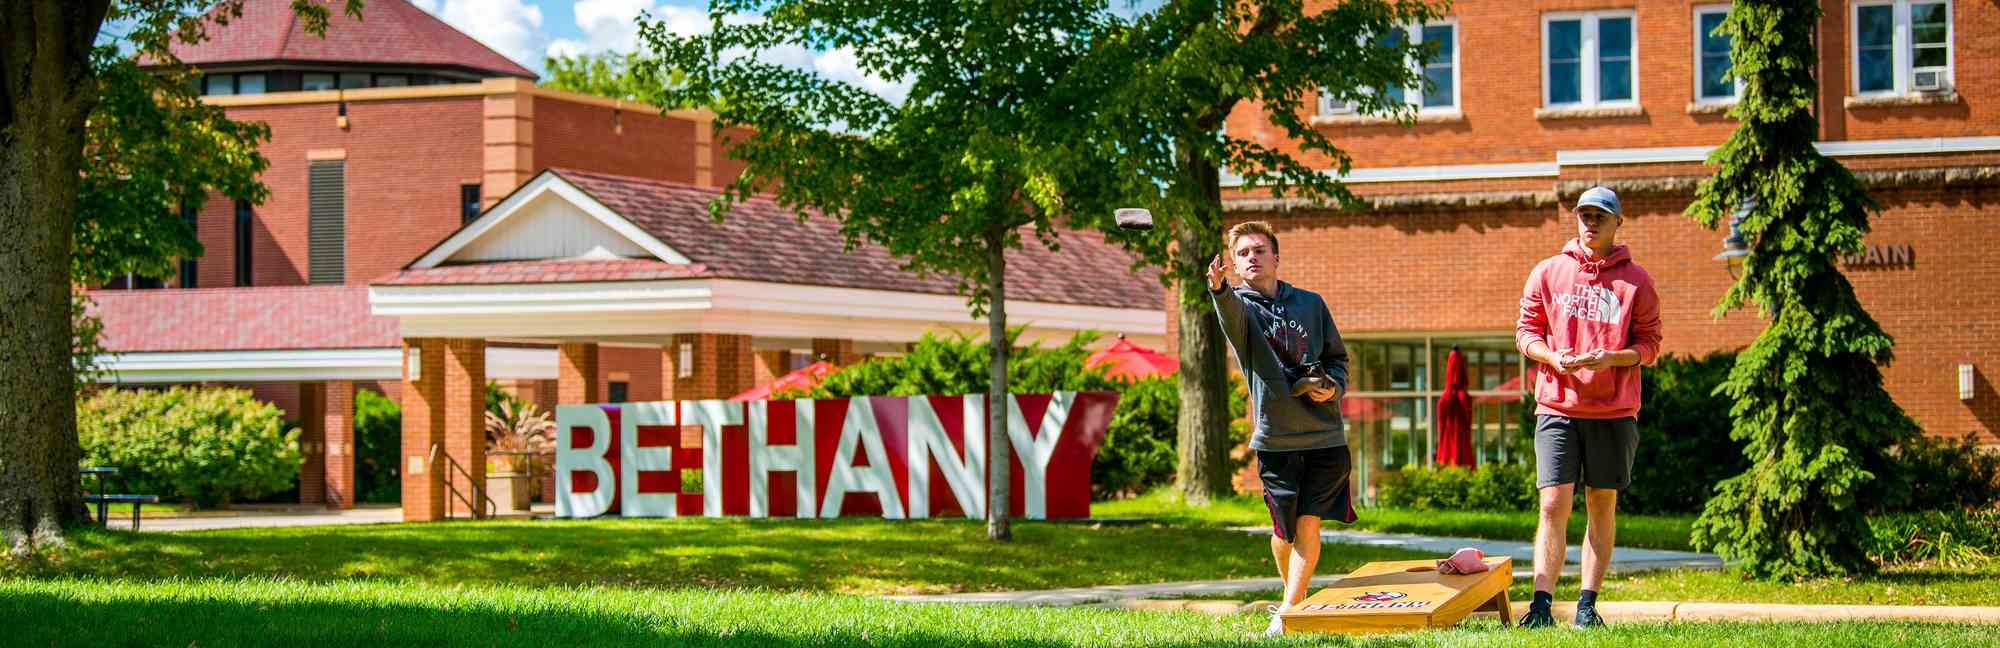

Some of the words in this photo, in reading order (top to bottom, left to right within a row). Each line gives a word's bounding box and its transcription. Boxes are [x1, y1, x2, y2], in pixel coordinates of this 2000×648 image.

[1574, 283, 1601, 298] THE
[1551, 292, 1598, 312] NORTH
[1563, 305, 1596, 321] FACE
[555, 391, 1076, 520] BETHANY
